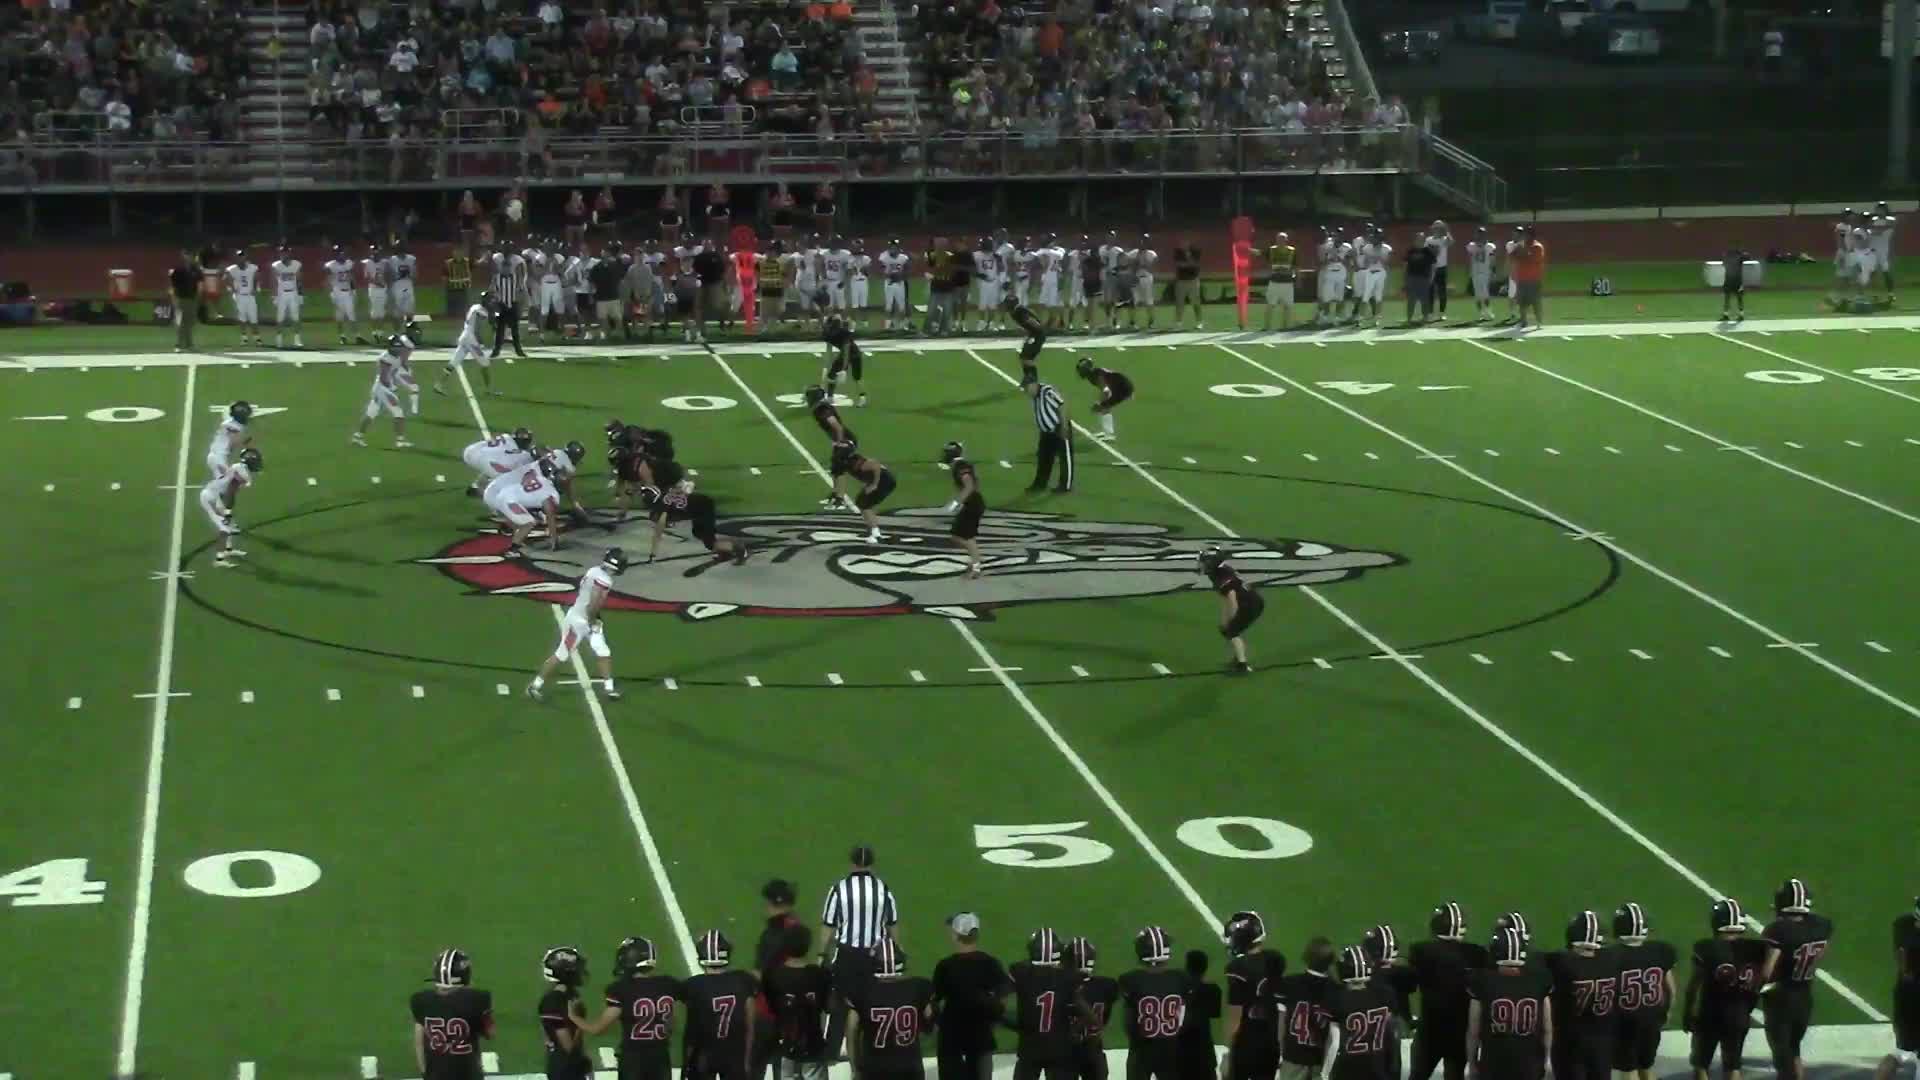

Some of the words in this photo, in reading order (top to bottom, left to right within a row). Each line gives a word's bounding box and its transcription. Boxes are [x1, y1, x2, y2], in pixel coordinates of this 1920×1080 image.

[1594, 279, 1611, 295] 30
[974, 821, 1114, 868] 5
[1176, 816, 1314, 859] 0
[0, 858, 107, 907] 4
[184, 850, 322, 898] 0
[1573, 977, 1617, 1016] 75
[1618, 966, 1666, 1011] 53
[630, 995, 675, 1041] 23
[712, 995, 737, 1039] 7
[870, 1005, 919, 1049] 79
[1036, 990, 1056, 1033] 1
[1137, 994, 1185, 1038] 89
[1346, 1005, 1391, 1054] 27
[1491, 997, 1539, 1037] 90
[424, 1016, 473, 1055] 52
